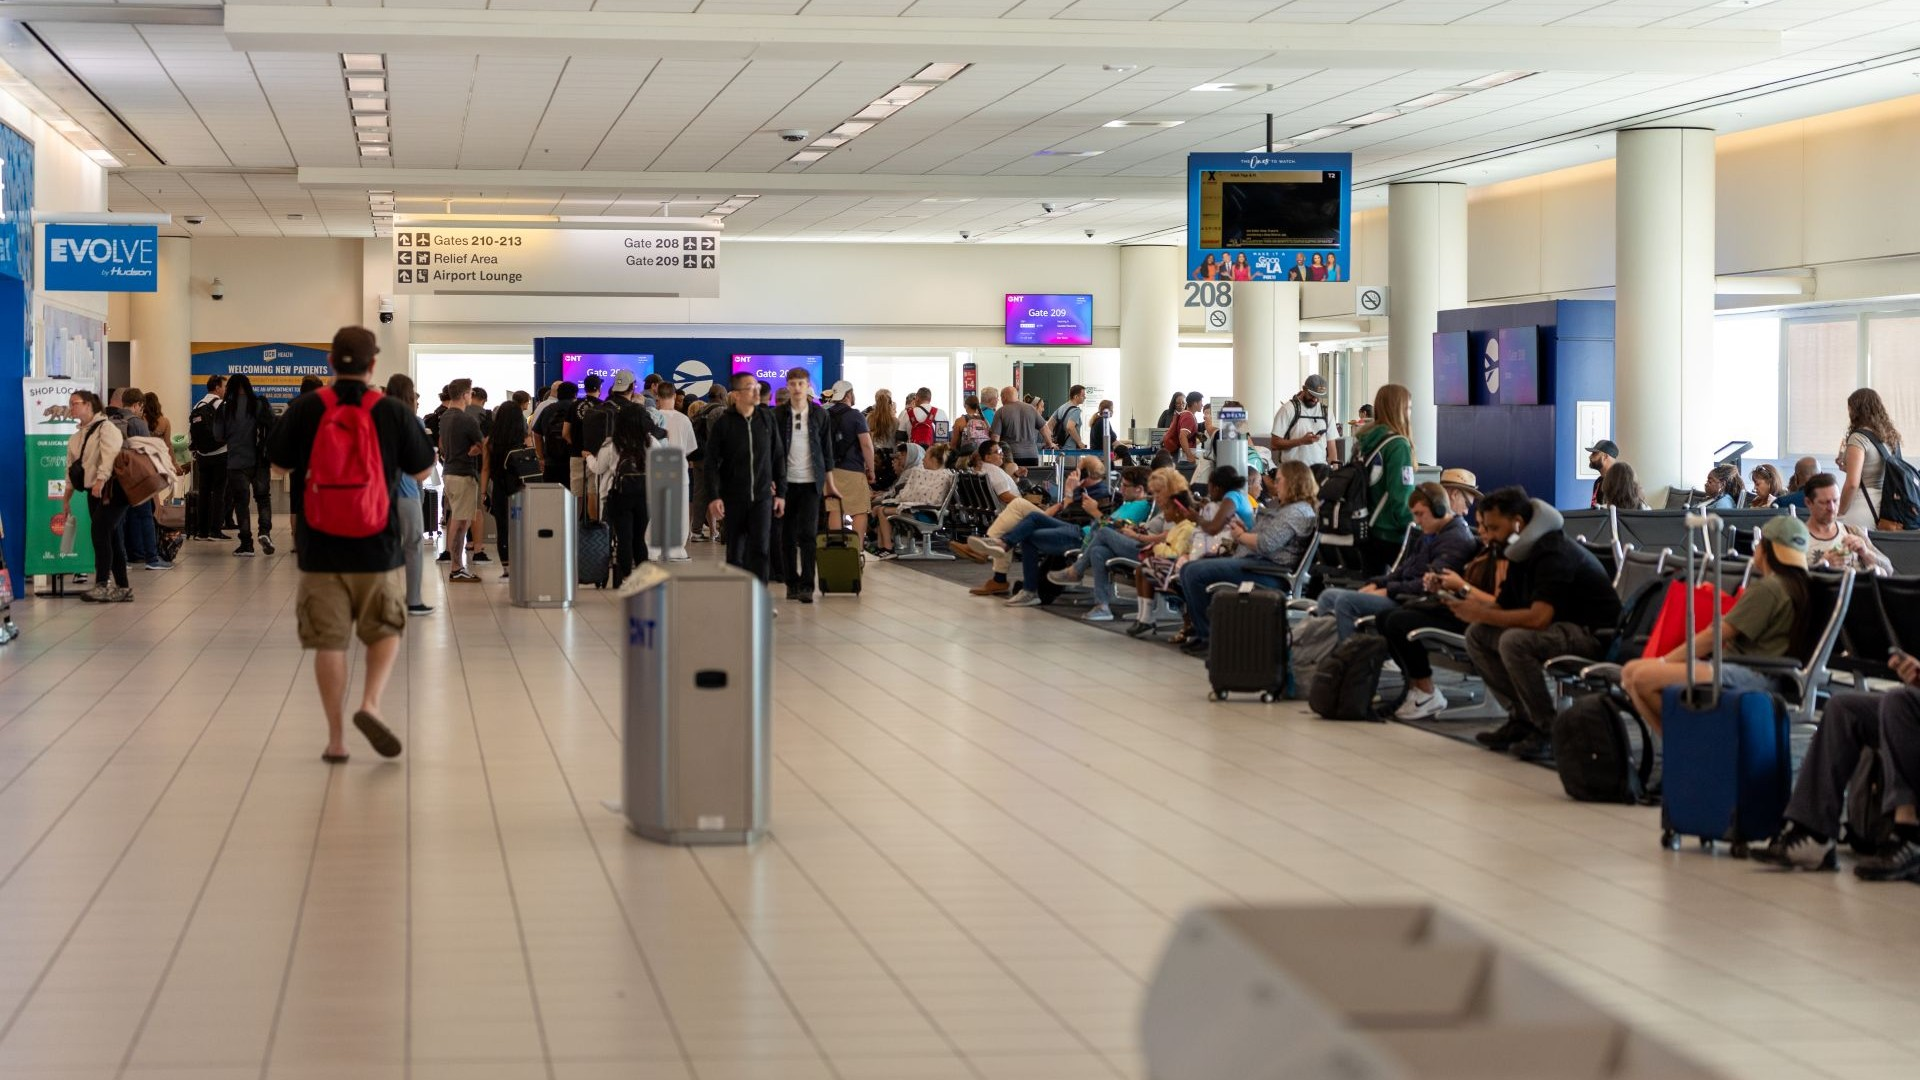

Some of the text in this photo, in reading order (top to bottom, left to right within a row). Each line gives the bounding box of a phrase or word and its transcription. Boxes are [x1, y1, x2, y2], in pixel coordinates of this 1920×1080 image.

[434, 235, 522, 246] Gates 210-213
[624, 238, 679, 248] Gate 208
[50, 238, 153, 264] EVOLVE
[434, 254, 498, 264] Relief Area
[626, 255, 679, 266] Gate 209
[110, 266, 152, 276] Hudson
[1266, 262, 1282, 273] LA
[433, 270, 522, 283] Airport Lounge
[1184, 281, 1232, 308] 208
[1028, 308, 1067, 317] Gate 209
[228, 364, 328, 375] WELCOMING NEW PATIENTS
[586, 368, 608, 377] Gate
[756, 369, 777, 378] Gate
[29, 386, 55, 397] SHOP
